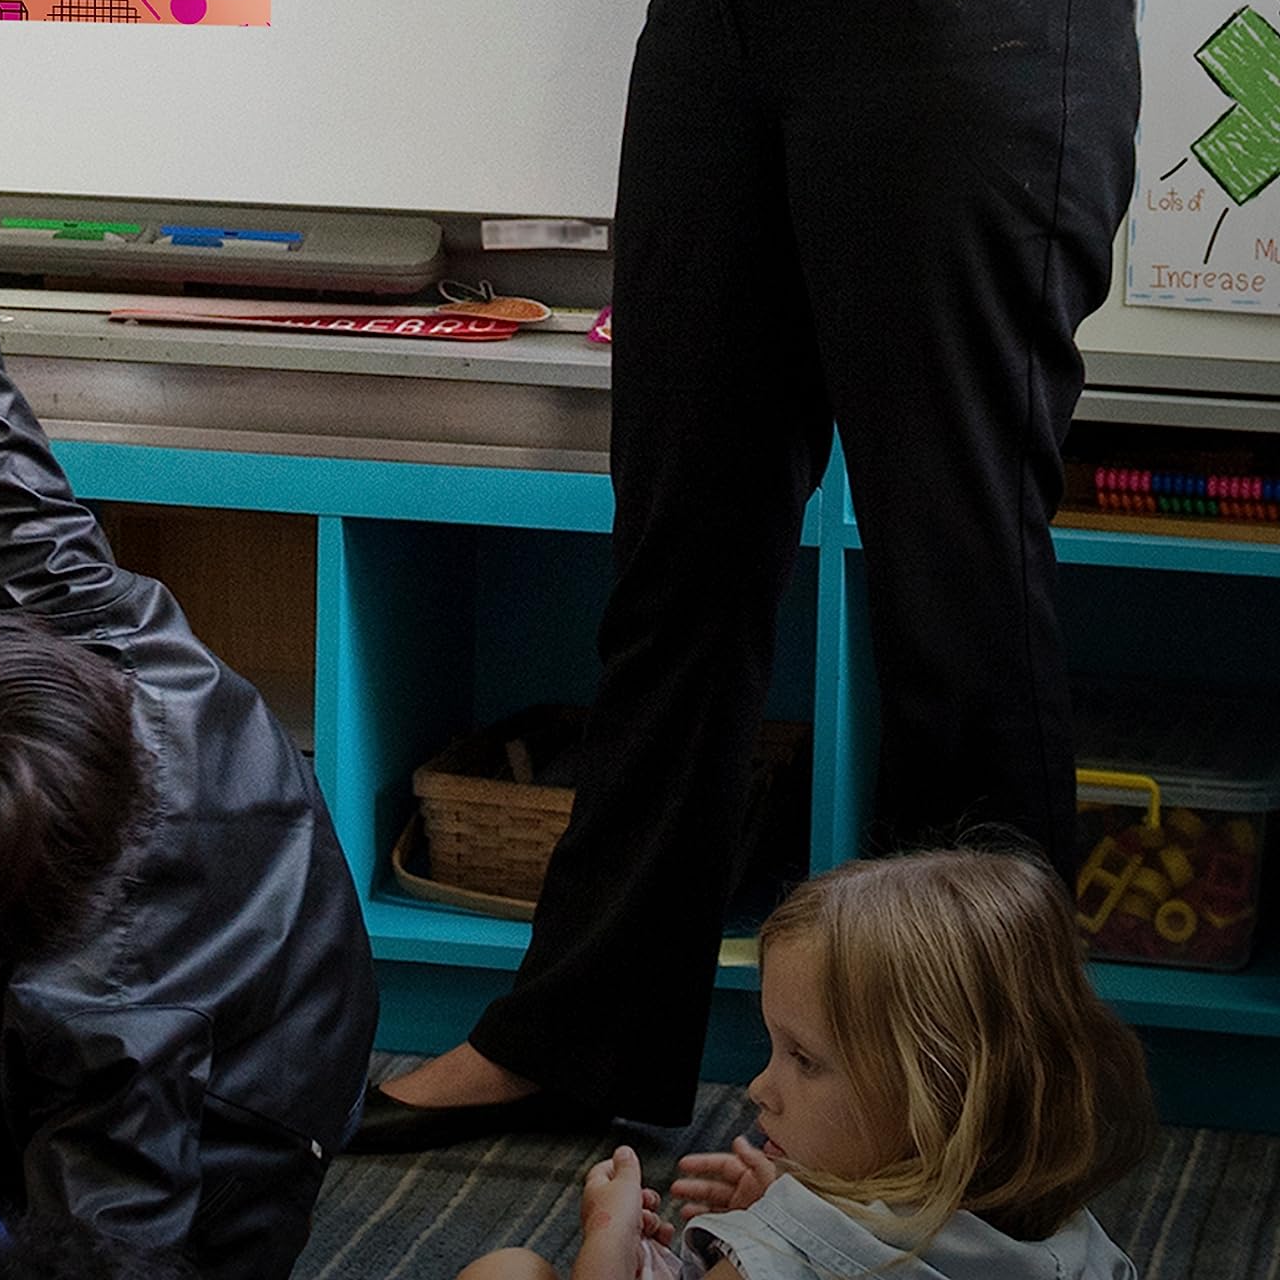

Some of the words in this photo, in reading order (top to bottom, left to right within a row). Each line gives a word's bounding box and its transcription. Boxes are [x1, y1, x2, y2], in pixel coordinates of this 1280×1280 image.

[1147, 187, 1183, 212] Lots
[1187, 187, 1205, 212] of
[1150, 264, 1266, 292] Increase
